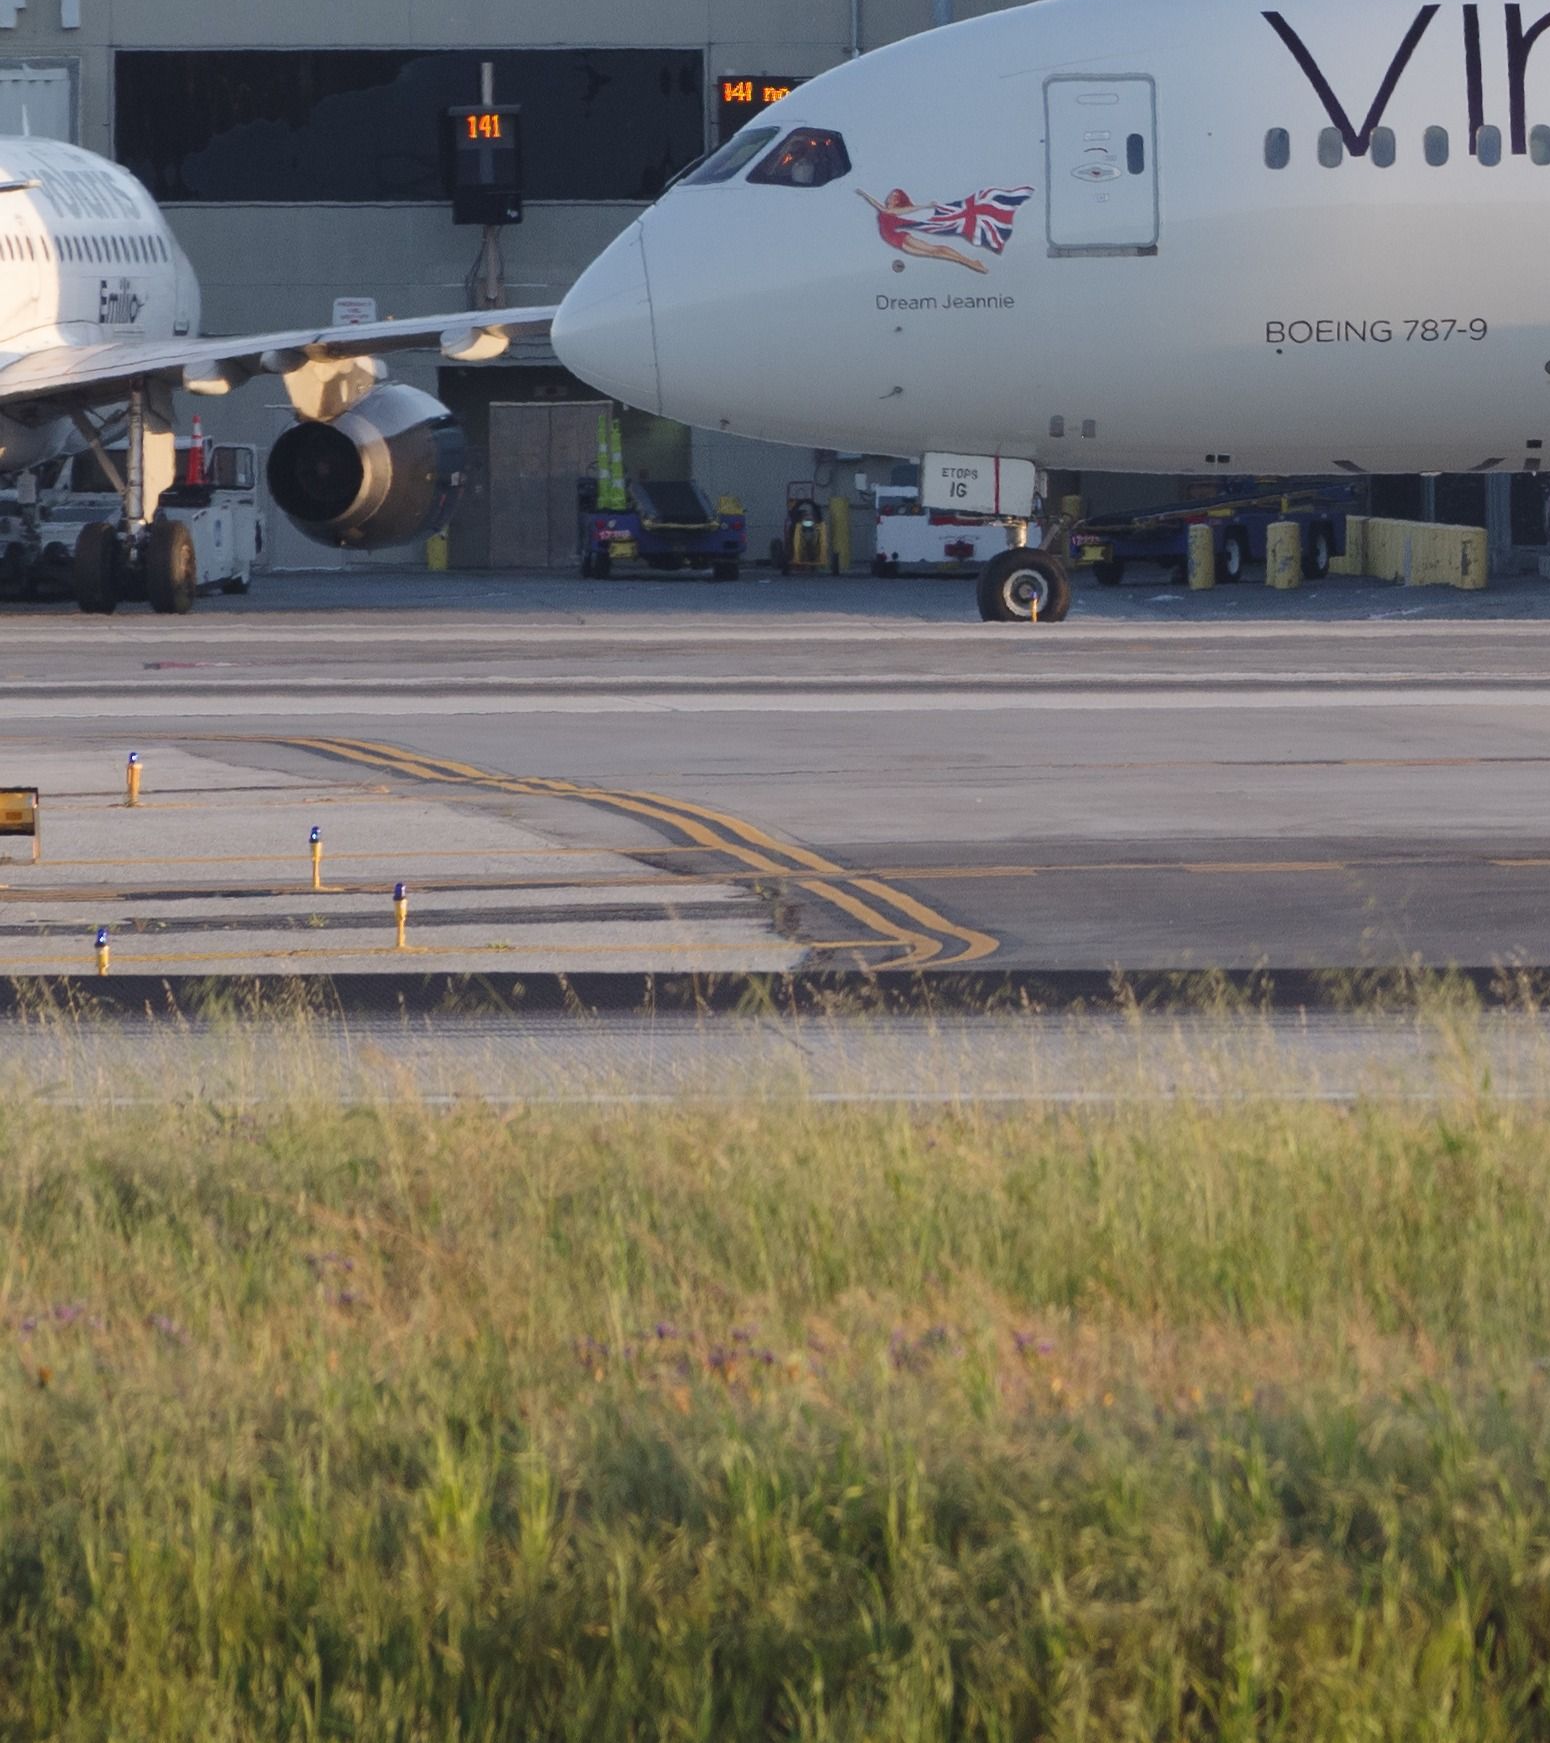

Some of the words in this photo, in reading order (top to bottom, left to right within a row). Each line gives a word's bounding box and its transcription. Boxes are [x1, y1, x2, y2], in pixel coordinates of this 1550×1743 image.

[467, 114, 502, 138] 141
[875, 294, 938, 311] Dream
[942, 293, 1016, 309] Jeannie
[1265, 319, 1393, 345] BOEING
[1402, 317, 1489, 343] 787-9
[941, 467, 979, 481] ETOPS
[950, 482, 968, 499] IG
